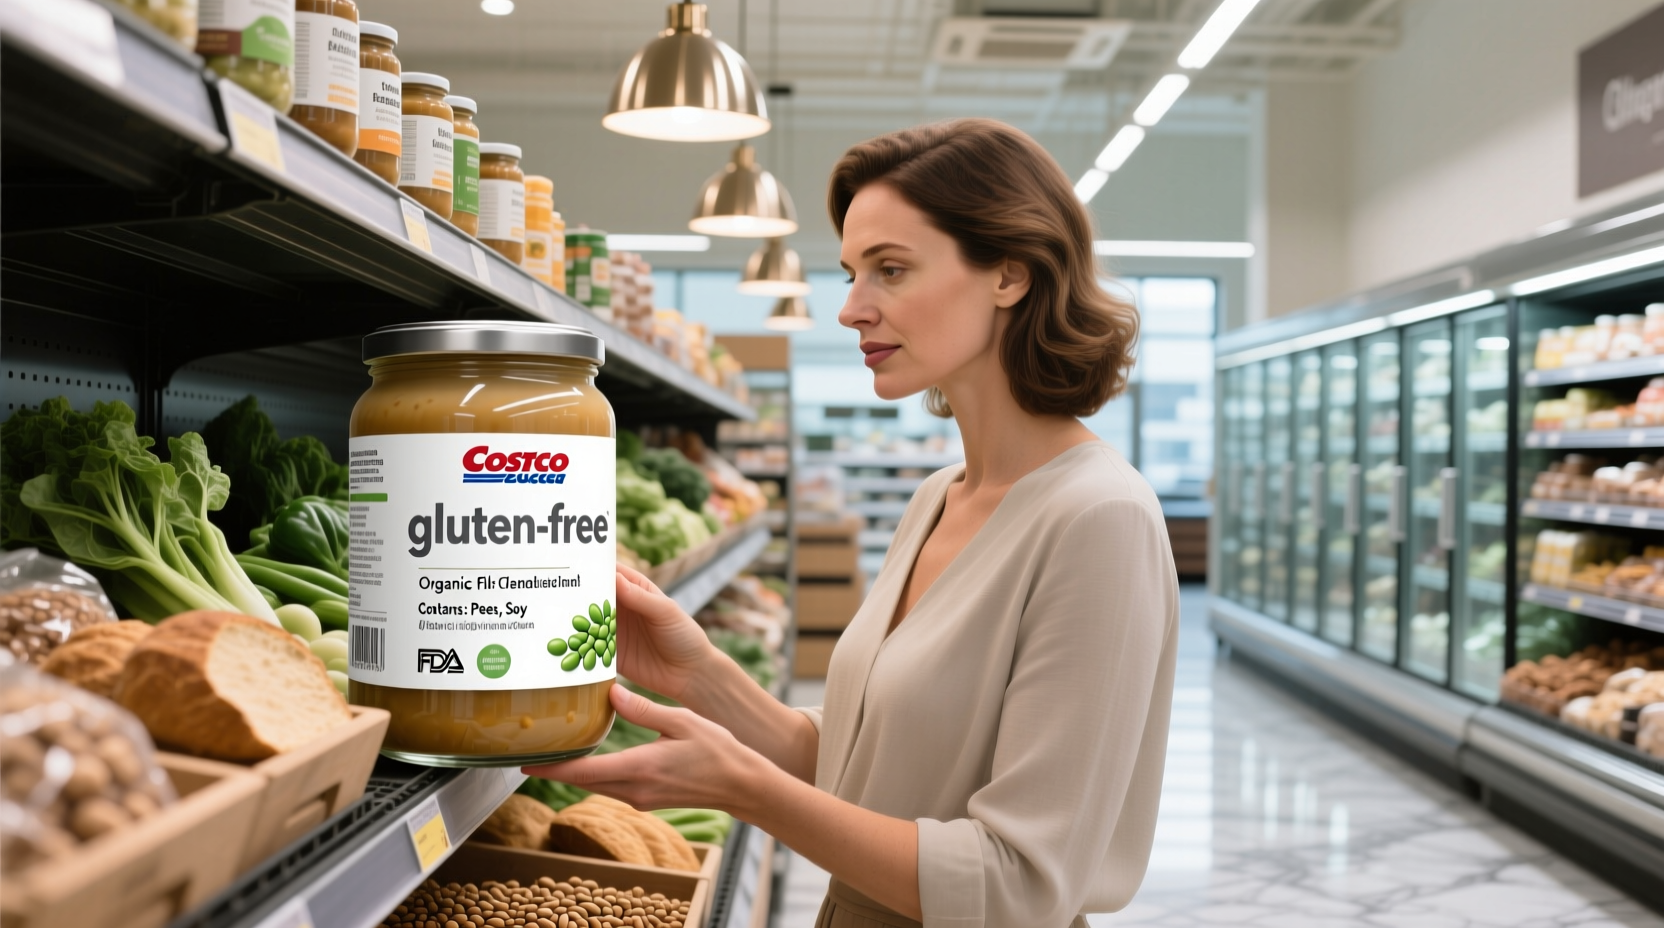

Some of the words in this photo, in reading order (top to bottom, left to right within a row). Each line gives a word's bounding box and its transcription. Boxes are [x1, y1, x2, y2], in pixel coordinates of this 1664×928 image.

[408, 502, 609, 558] gluten-free
[418, 575, 473, 594] Organic
[505, 601, 528, 618] Soy
[417, 648, 465, 674] FDA
